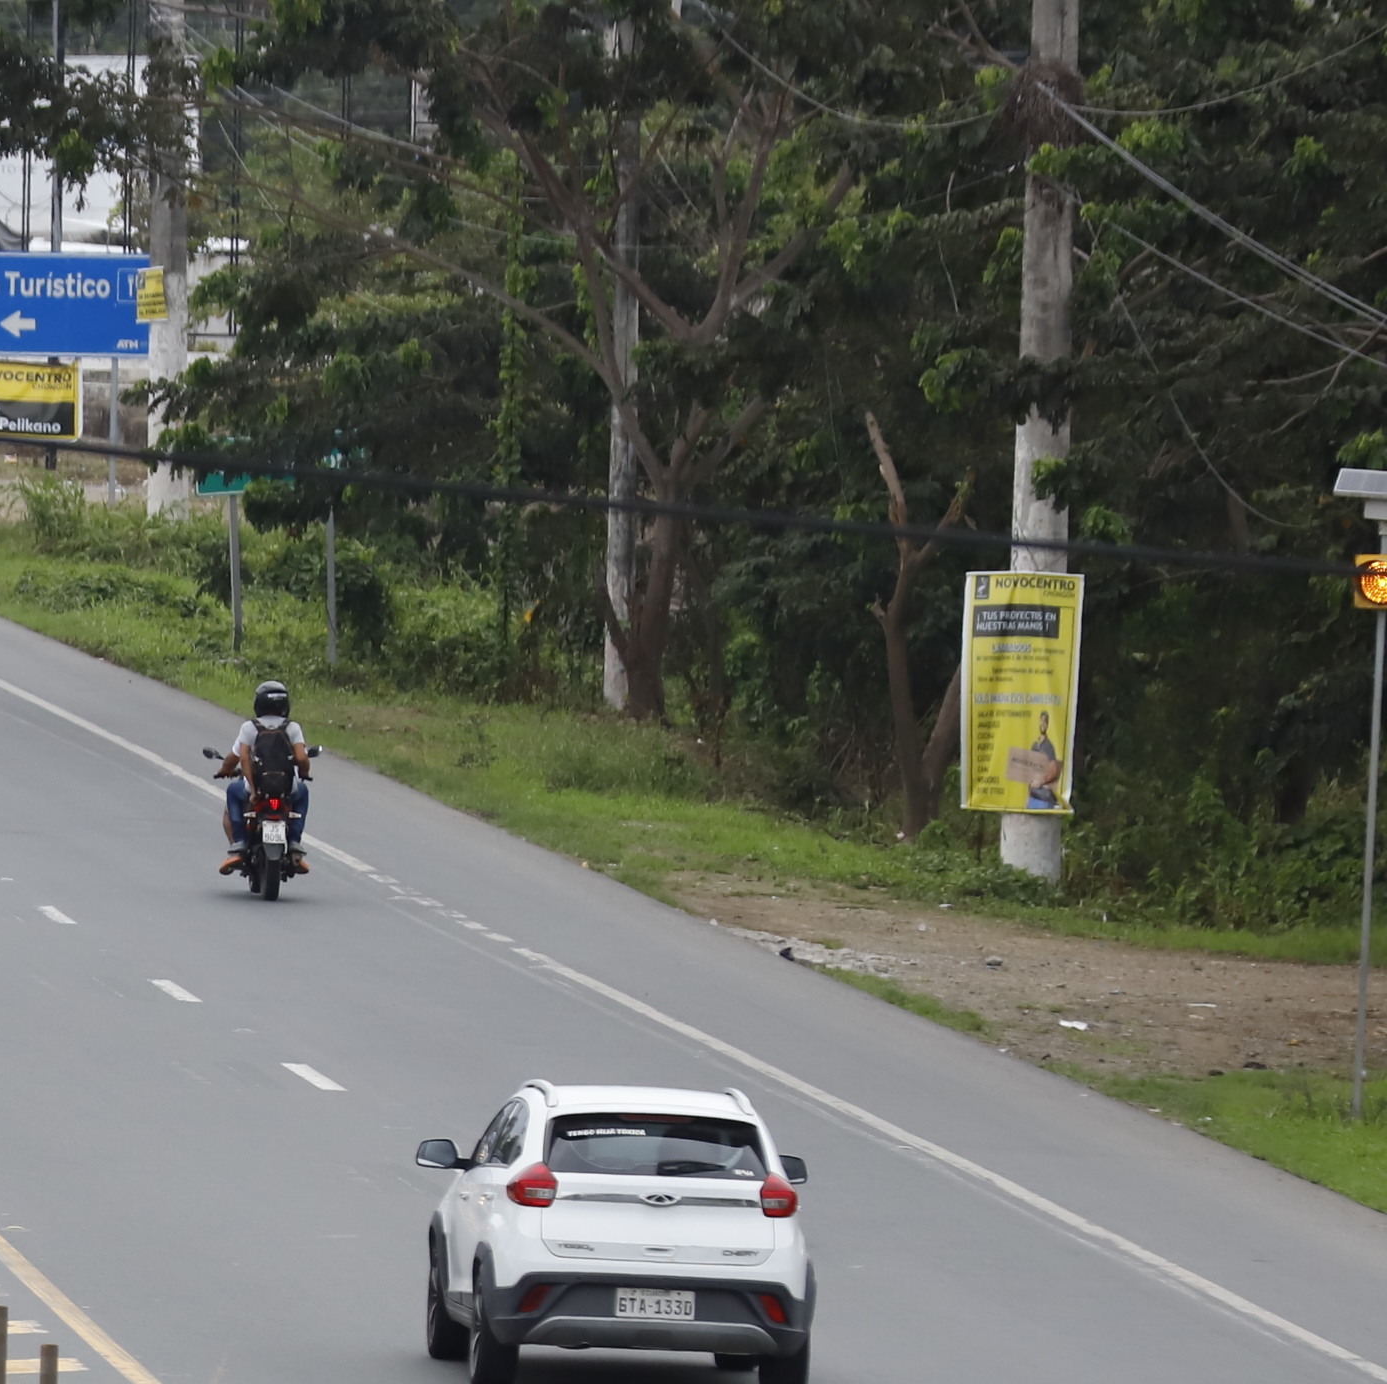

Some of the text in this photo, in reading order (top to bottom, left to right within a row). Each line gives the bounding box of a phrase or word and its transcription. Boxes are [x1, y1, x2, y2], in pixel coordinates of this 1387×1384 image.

[4, 270, 111, 299] Turístico
[995, 577, 1076, 591] NOVOCENTRO
[982, 611, 998, 621] TUS
[722, 1249, 760, 1257] CHERY
[618, 1297, 693, 1316] GTA-1330
